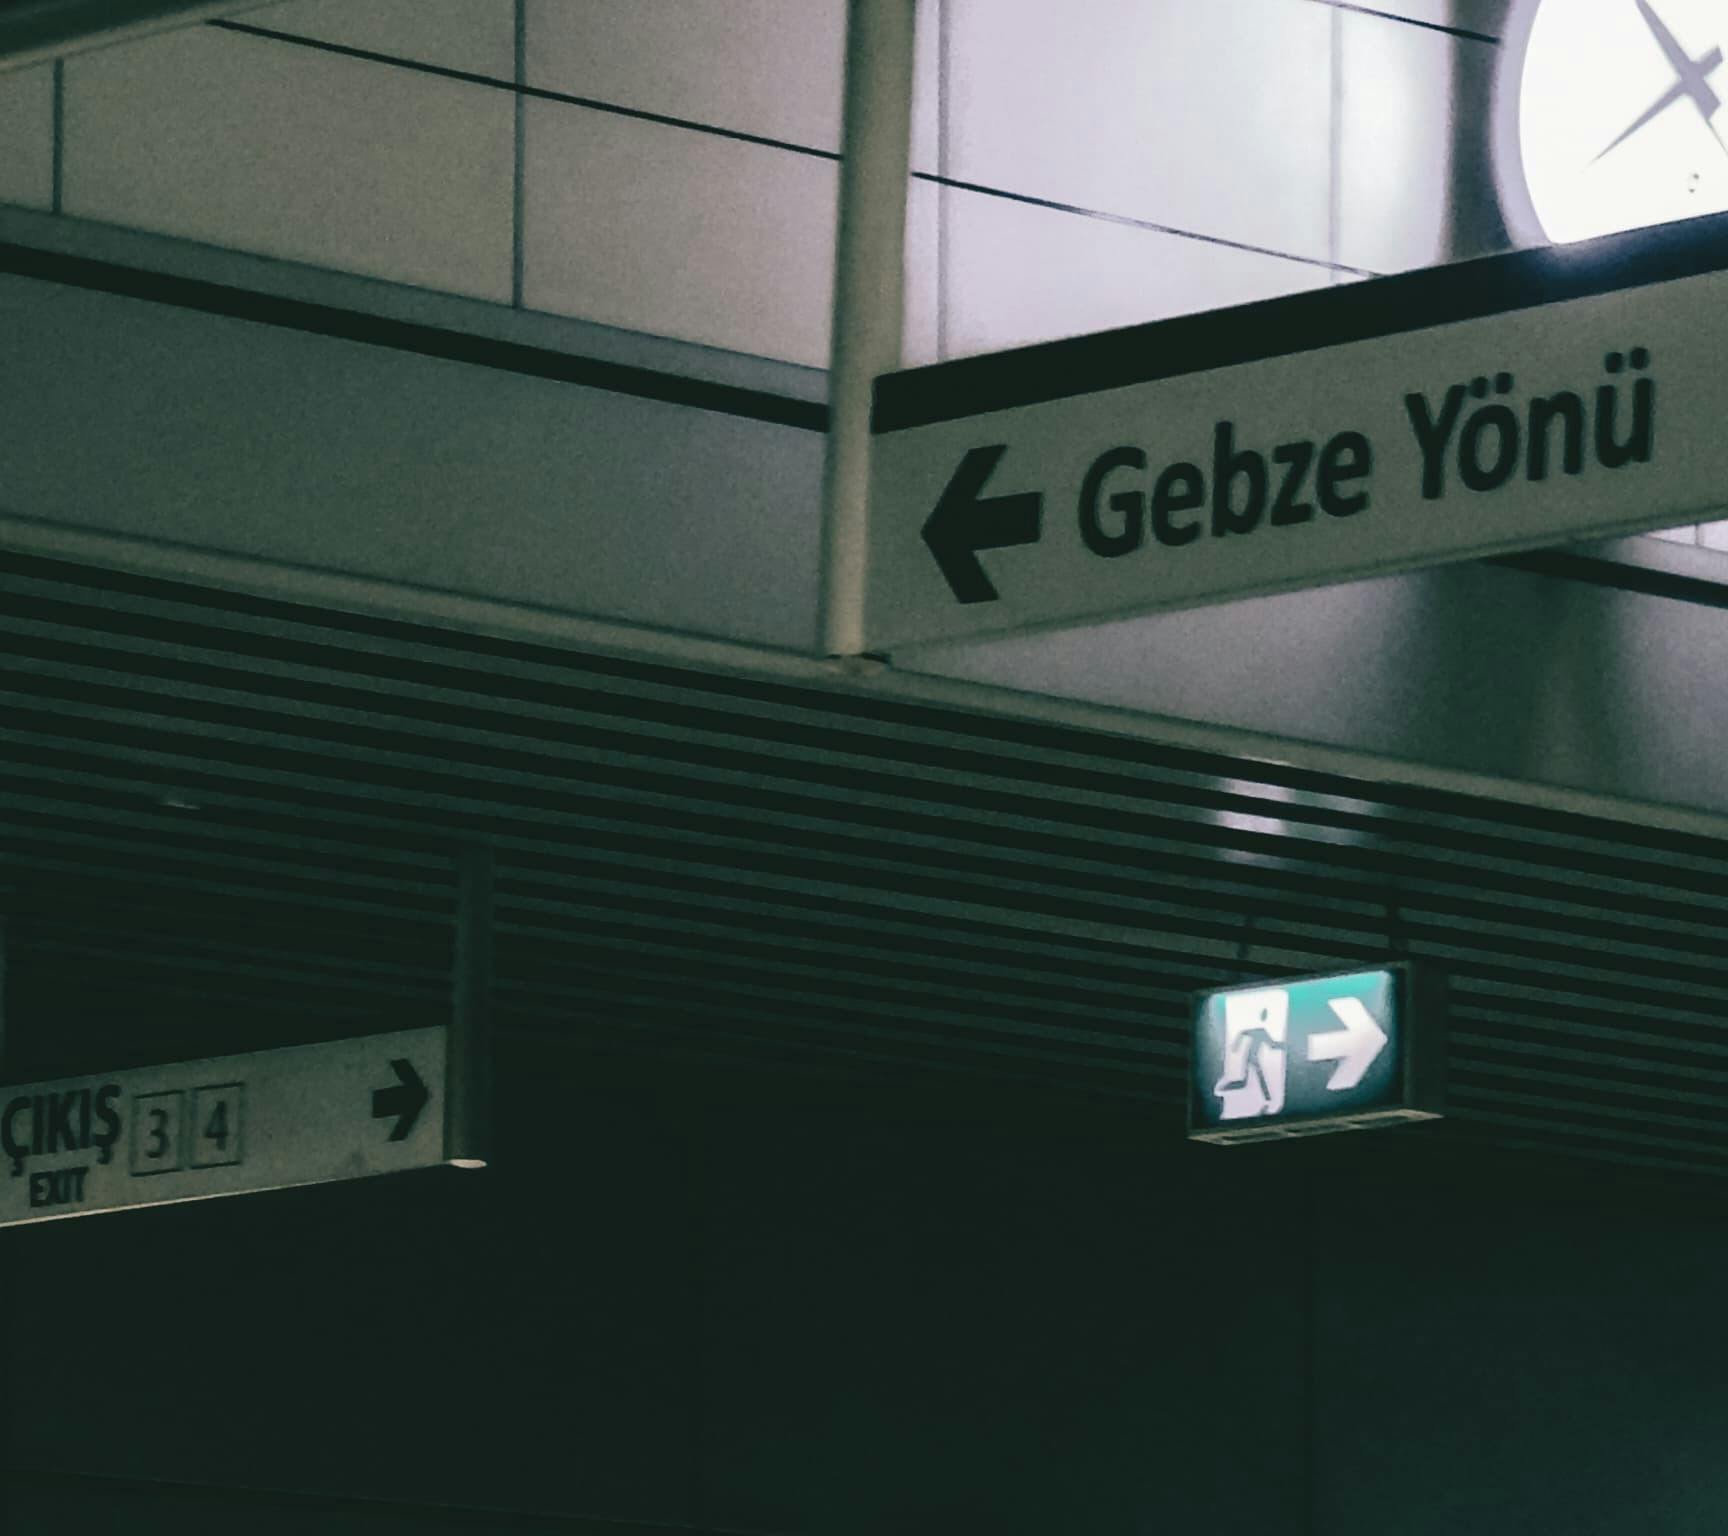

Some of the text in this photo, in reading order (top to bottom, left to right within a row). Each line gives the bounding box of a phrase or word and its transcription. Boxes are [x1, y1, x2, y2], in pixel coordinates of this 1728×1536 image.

[1076, 346, 1656, 559] Gebze Yönü
[1, 1083, 229, 1177] ÇIKIŞ 3 4
[29, 1166, 90, 1208] EXIT
